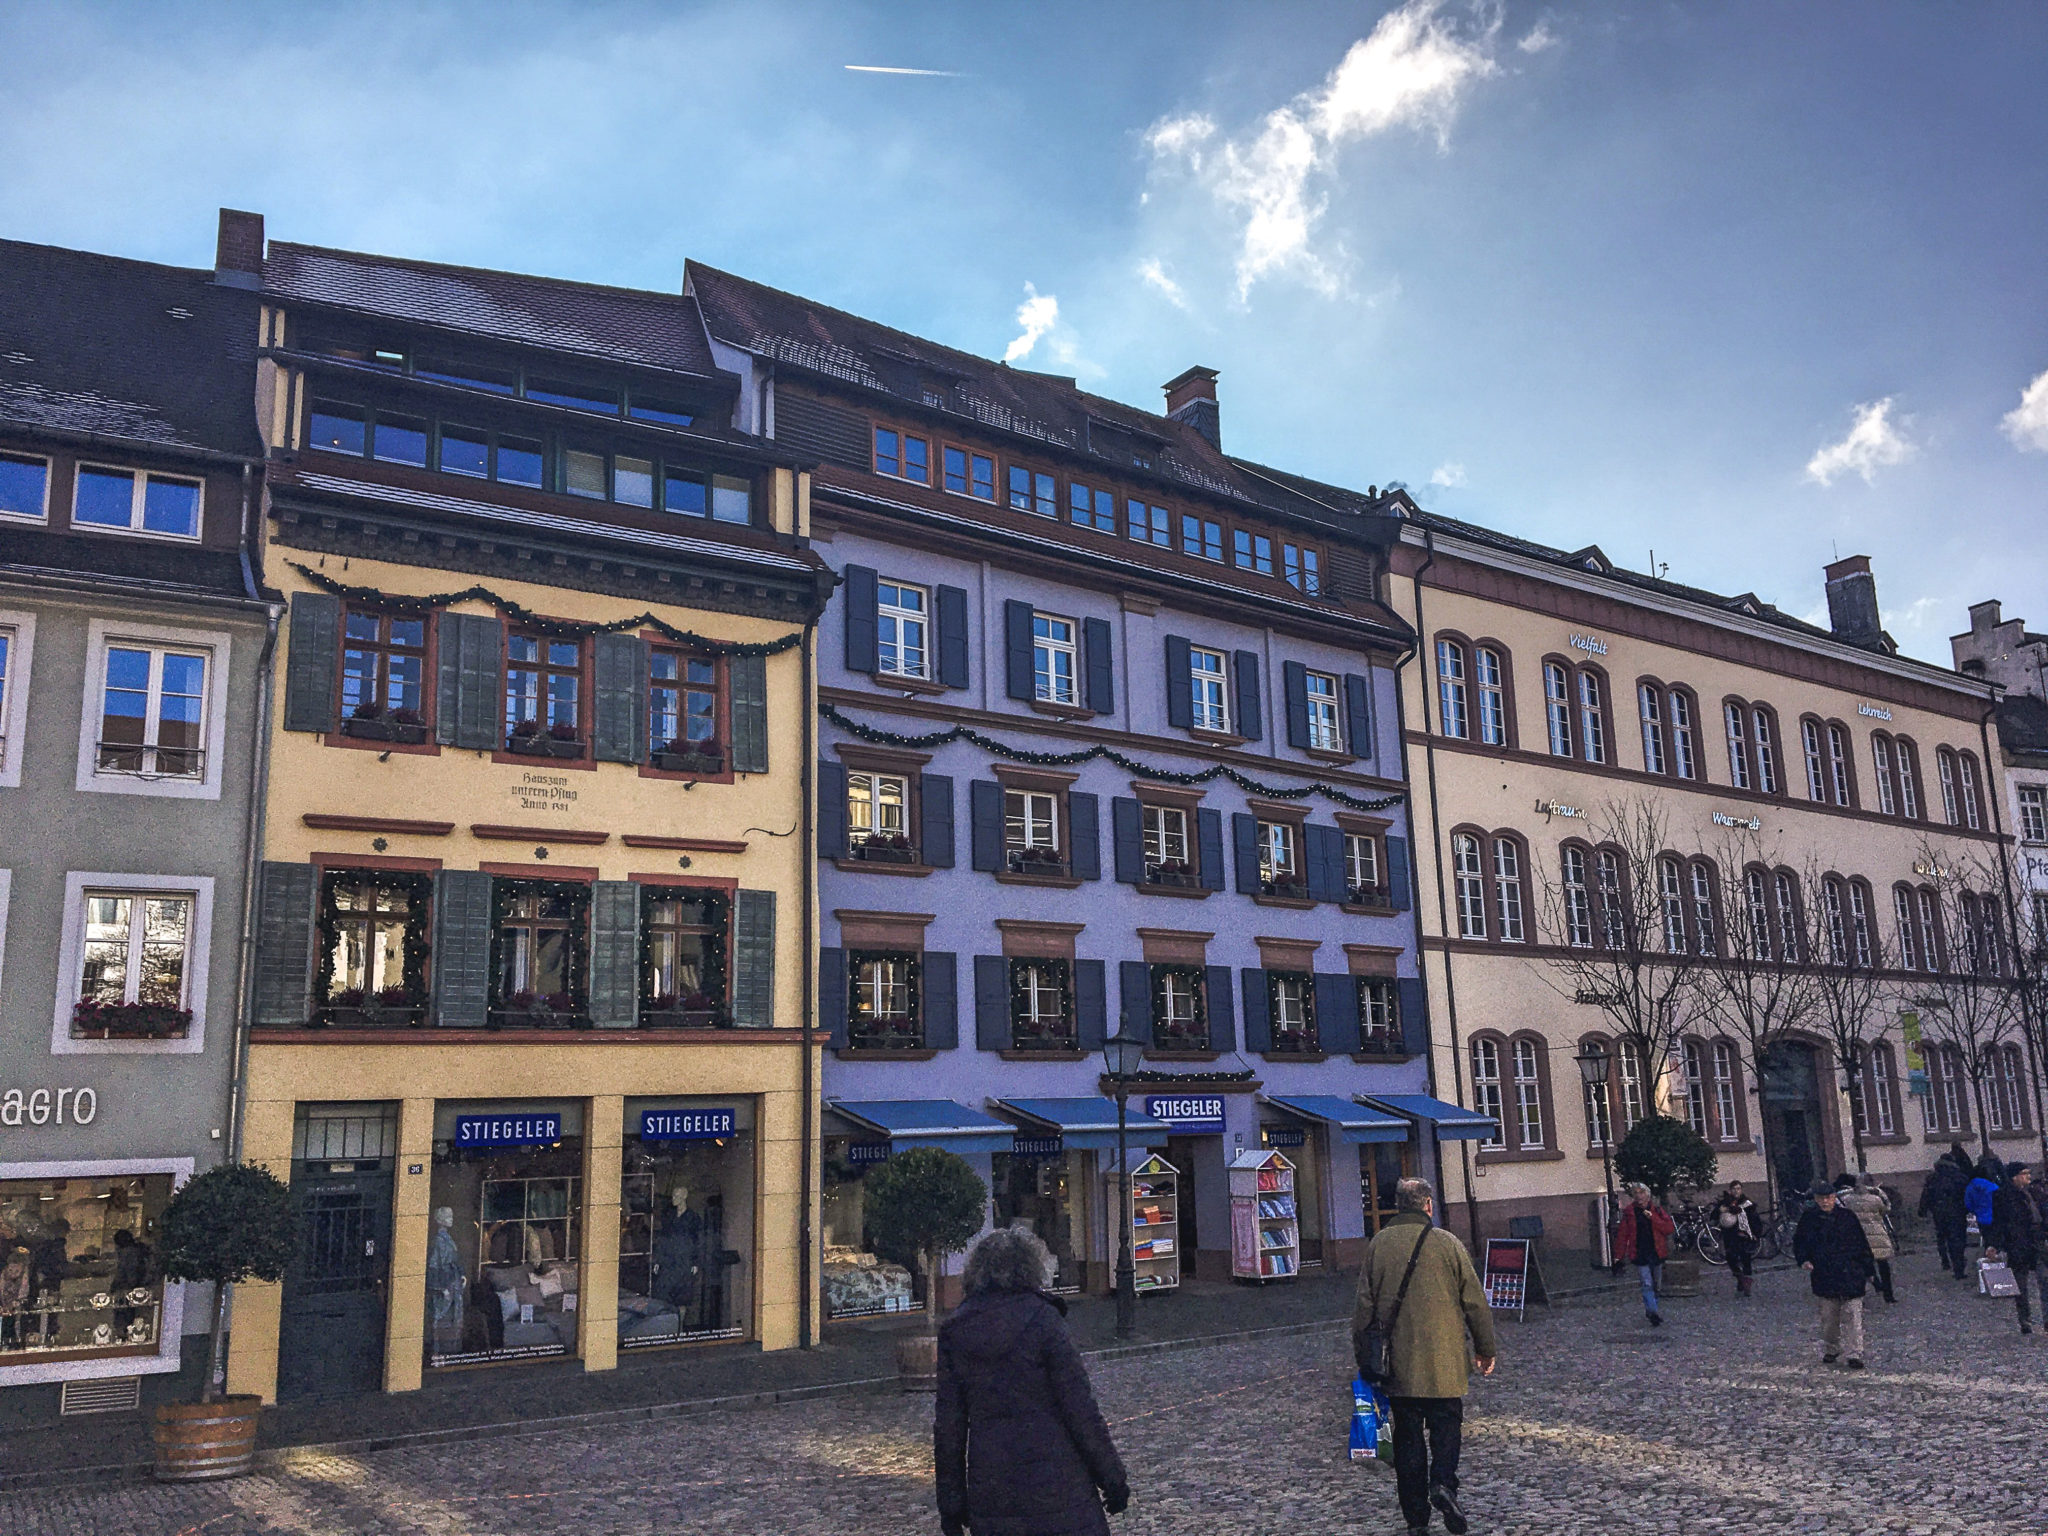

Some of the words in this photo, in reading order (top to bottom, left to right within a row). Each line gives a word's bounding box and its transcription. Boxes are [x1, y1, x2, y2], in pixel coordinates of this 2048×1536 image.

[1569, 633, 1608, 660] Vielfalt
[1858, 702, 1892, 721] Lehrreich
[521, 797, 547, 810] Anno
[1153, 1100, 1222, 1117] STIEGELER
[461, 1120, 555, 1140] STIEGELER
[646, 1115, 730, 1134] STIEGELER
[1014, 1140, 1060, 1153] STIEGELER
[410, 1165, 420, 1174] 36
